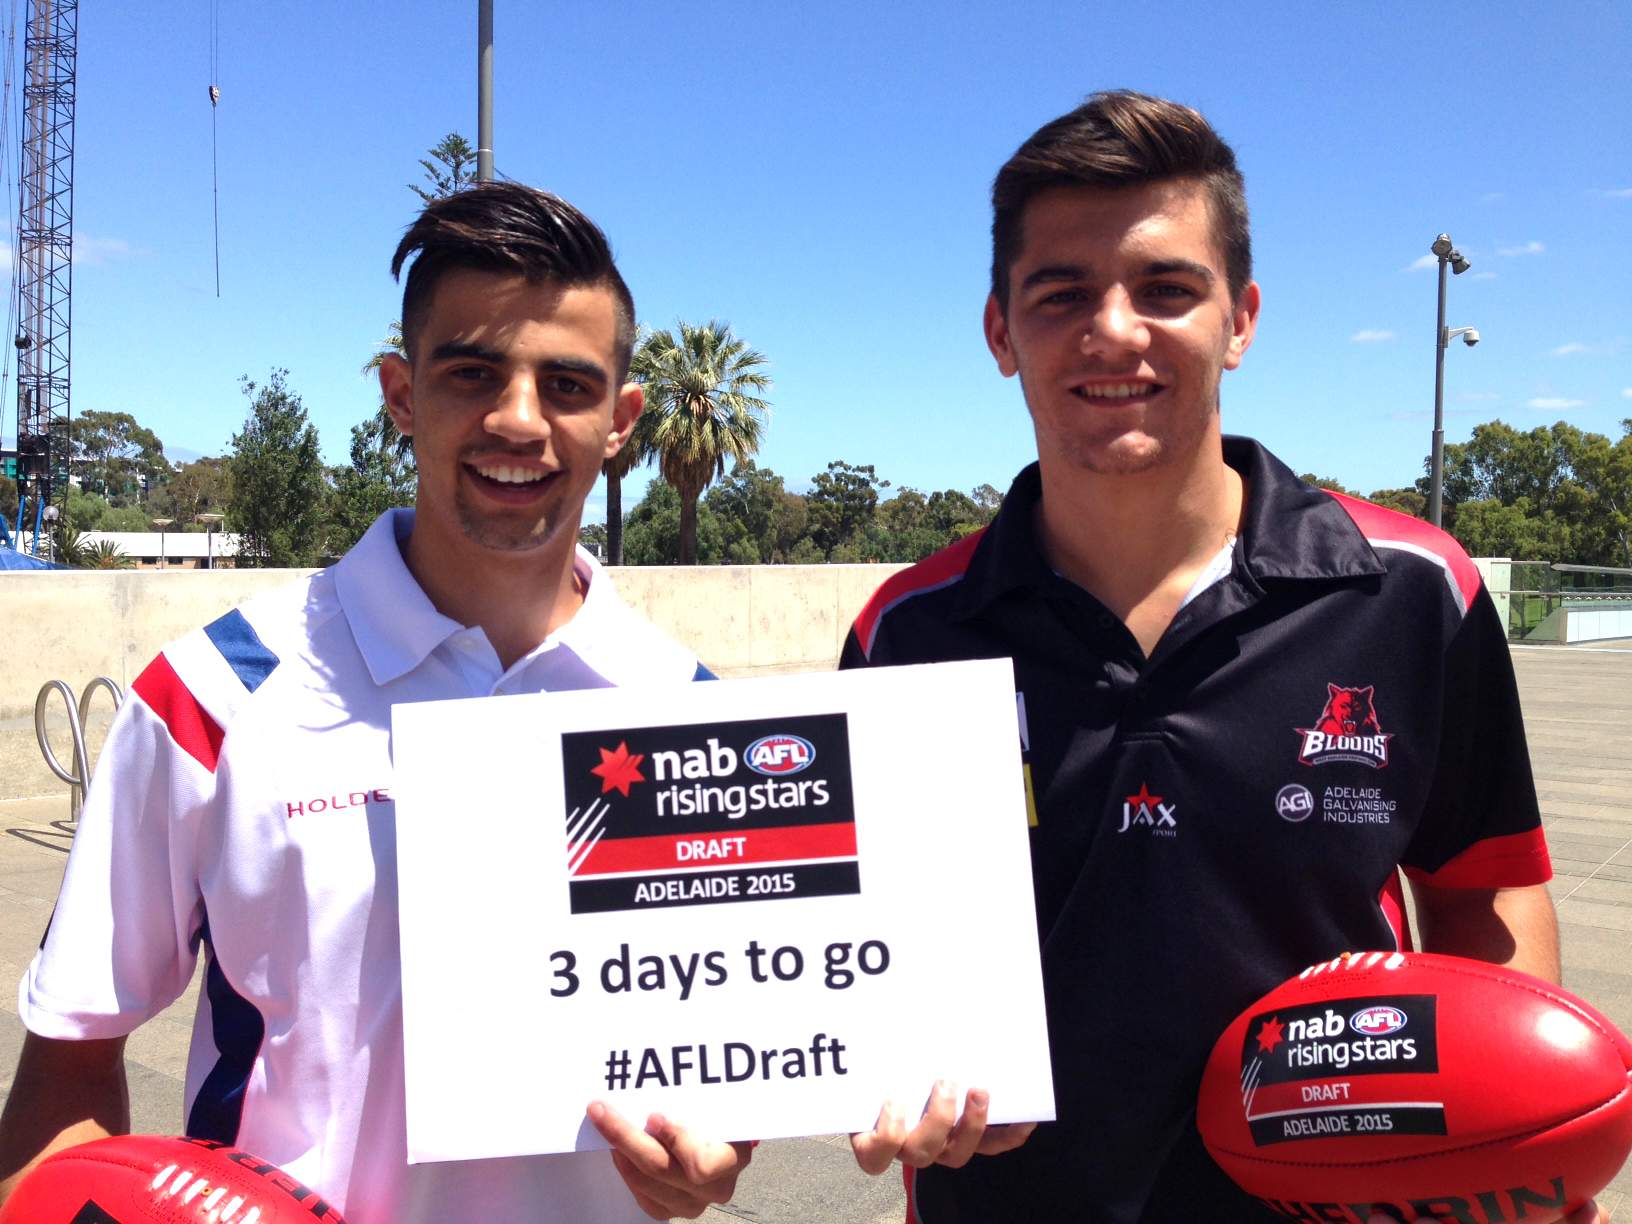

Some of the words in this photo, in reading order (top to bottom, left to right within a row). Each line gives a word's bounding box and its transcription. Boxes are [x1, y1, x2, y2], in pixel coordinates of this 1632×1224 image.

[651, 738, 738, 781] nab
[750, 742, 809, 768] AFL
[1303, 730, 1388, 761] BLOODS
[287, 789, 391, 819] HOLDE
[1279, 791, 1312, 814] AGI
[1323, 786, 1382, 799] ADELAIDE
[1323, 799, 1397, 811] GALVANISING
[1117, 801, 1177, 833] JAX
[1323, 811, 1390, 824] INDUSTRIES
[676, 837, 747, 861] DRAFT
[634, 876, 740, 903] ADELAIDE
[746, 873, 796, 895] 2015
[550, 950, 580, 997] 3
[600, 943, 728, 1001] days
[745, 940, 804, 983] to
[824, 940, 891, 990] go
[1288, 1009, 1345, 1041] nab
[1355, 1012, 1402, 1030] AFL
[604, 1033, 848, 1091] #AFLDraft
[1301, 1083, 1350, 1102] DRAFT
[1283, 1115, 1351, 1137] ADELAIDE
[1354, 1114, 1394, 1131] 2015
